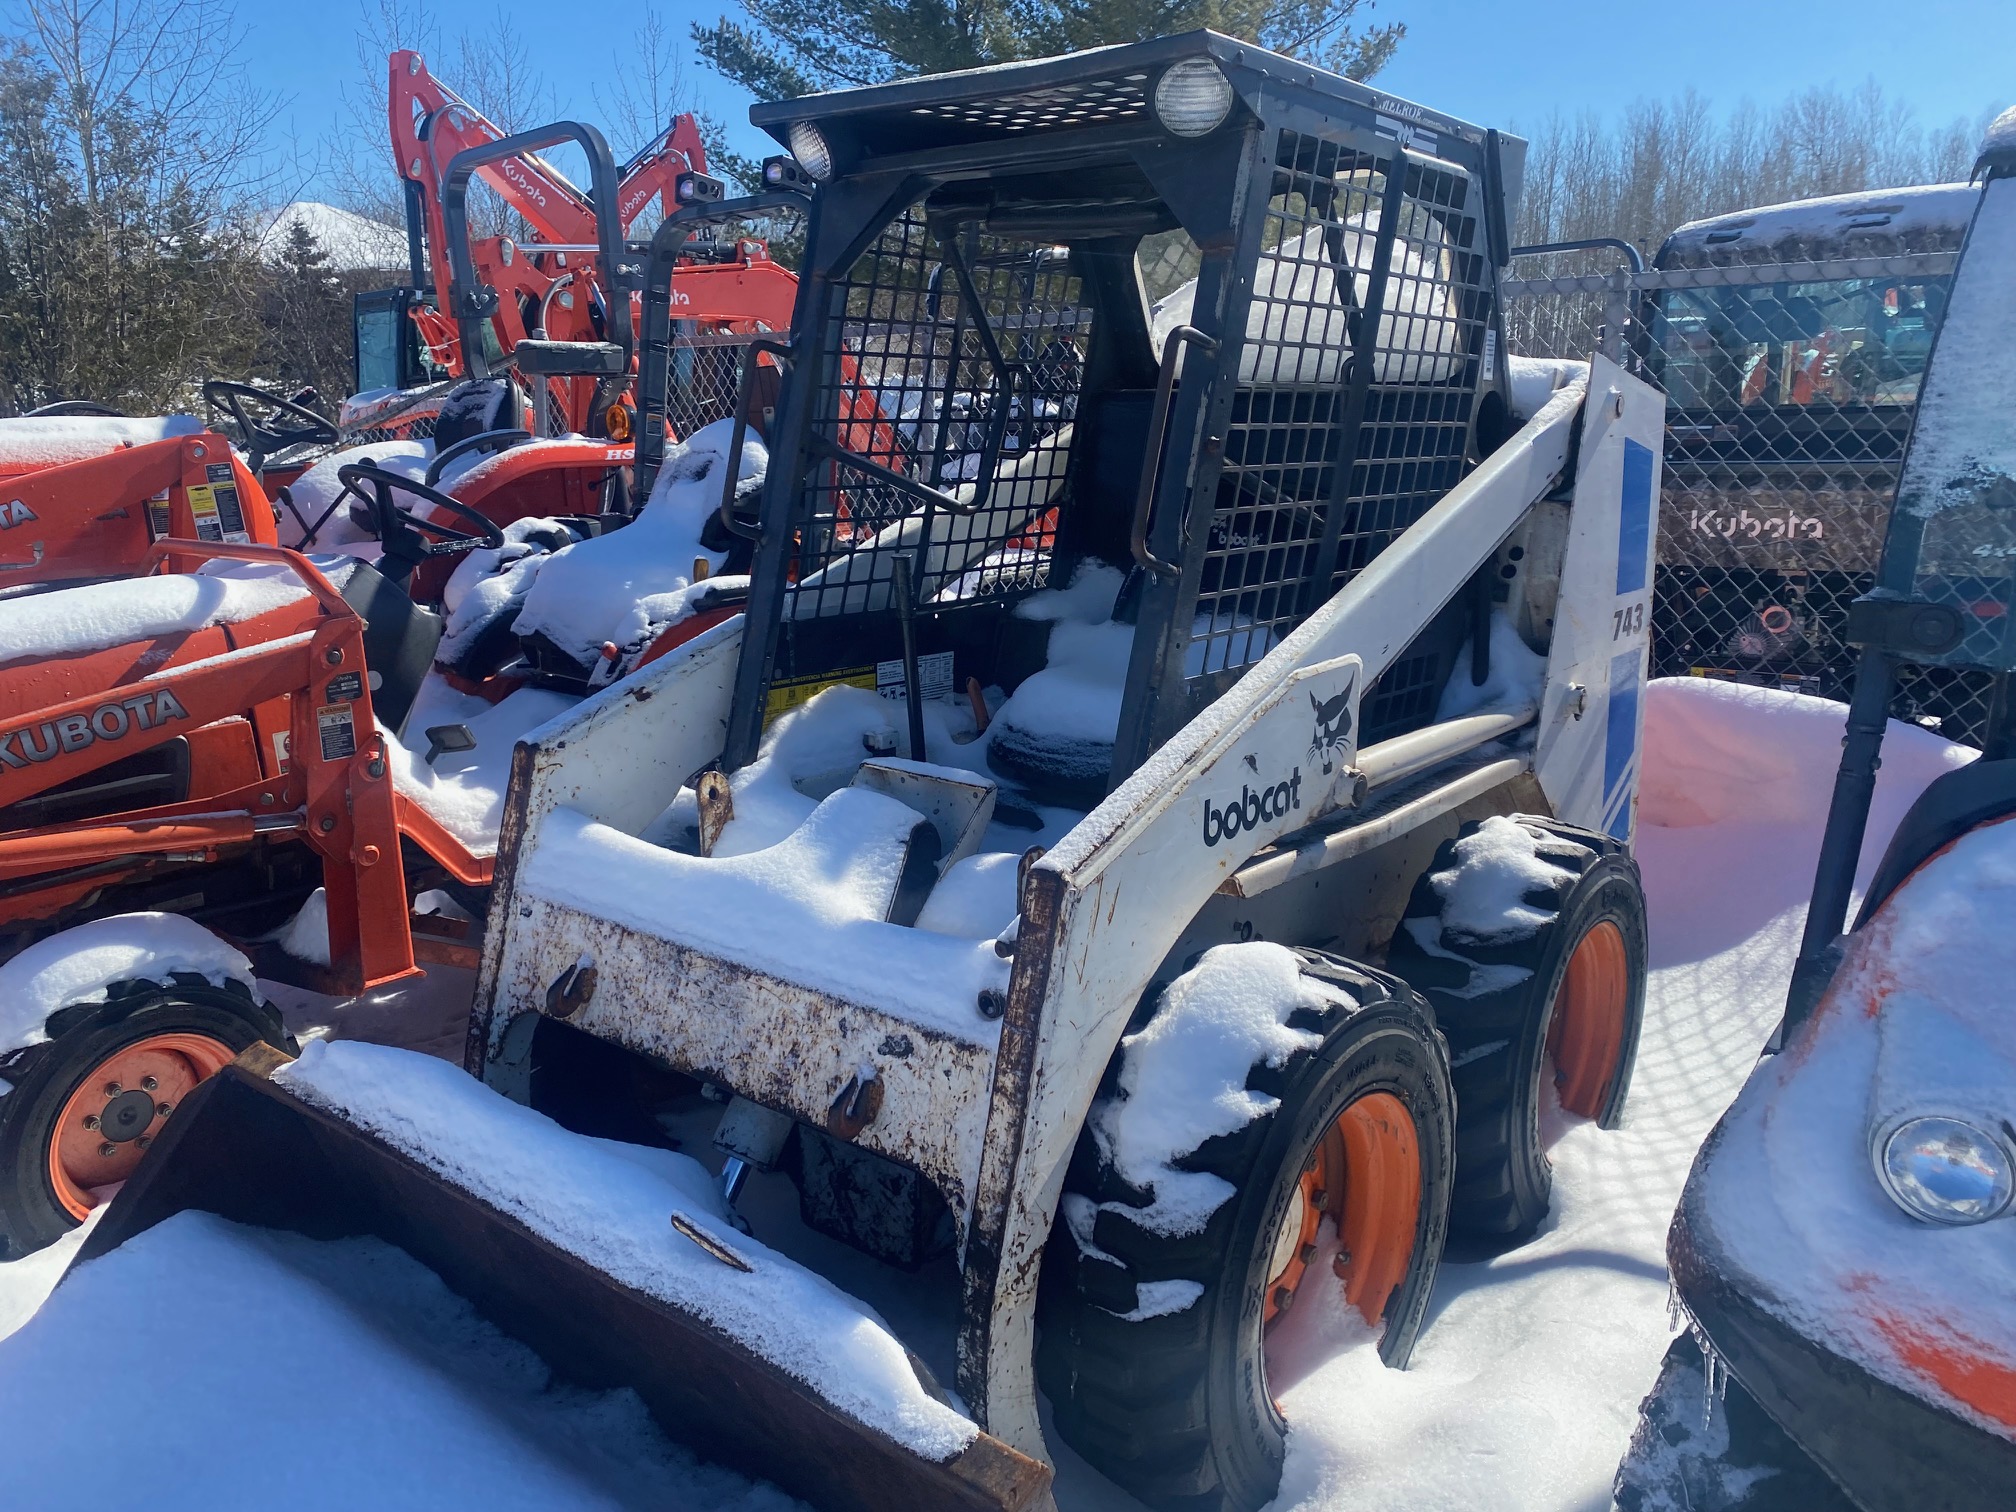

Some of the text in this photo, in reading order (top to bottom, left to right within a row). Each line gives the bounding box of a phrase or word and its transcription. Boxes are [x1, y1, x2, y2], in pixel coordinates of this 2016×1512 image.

[1379, 100, 1424, 119] MELROE
[501, 159, 546, 208] Kubota
[631, 289, 690, 305] Kta
[1690, 509, 1823, 538] Kubota
[1613, 603, 1644, 641] 743
[0, 688, 190, 774] KUBOTA
[1203, 766, 1302, 847] bobcat
